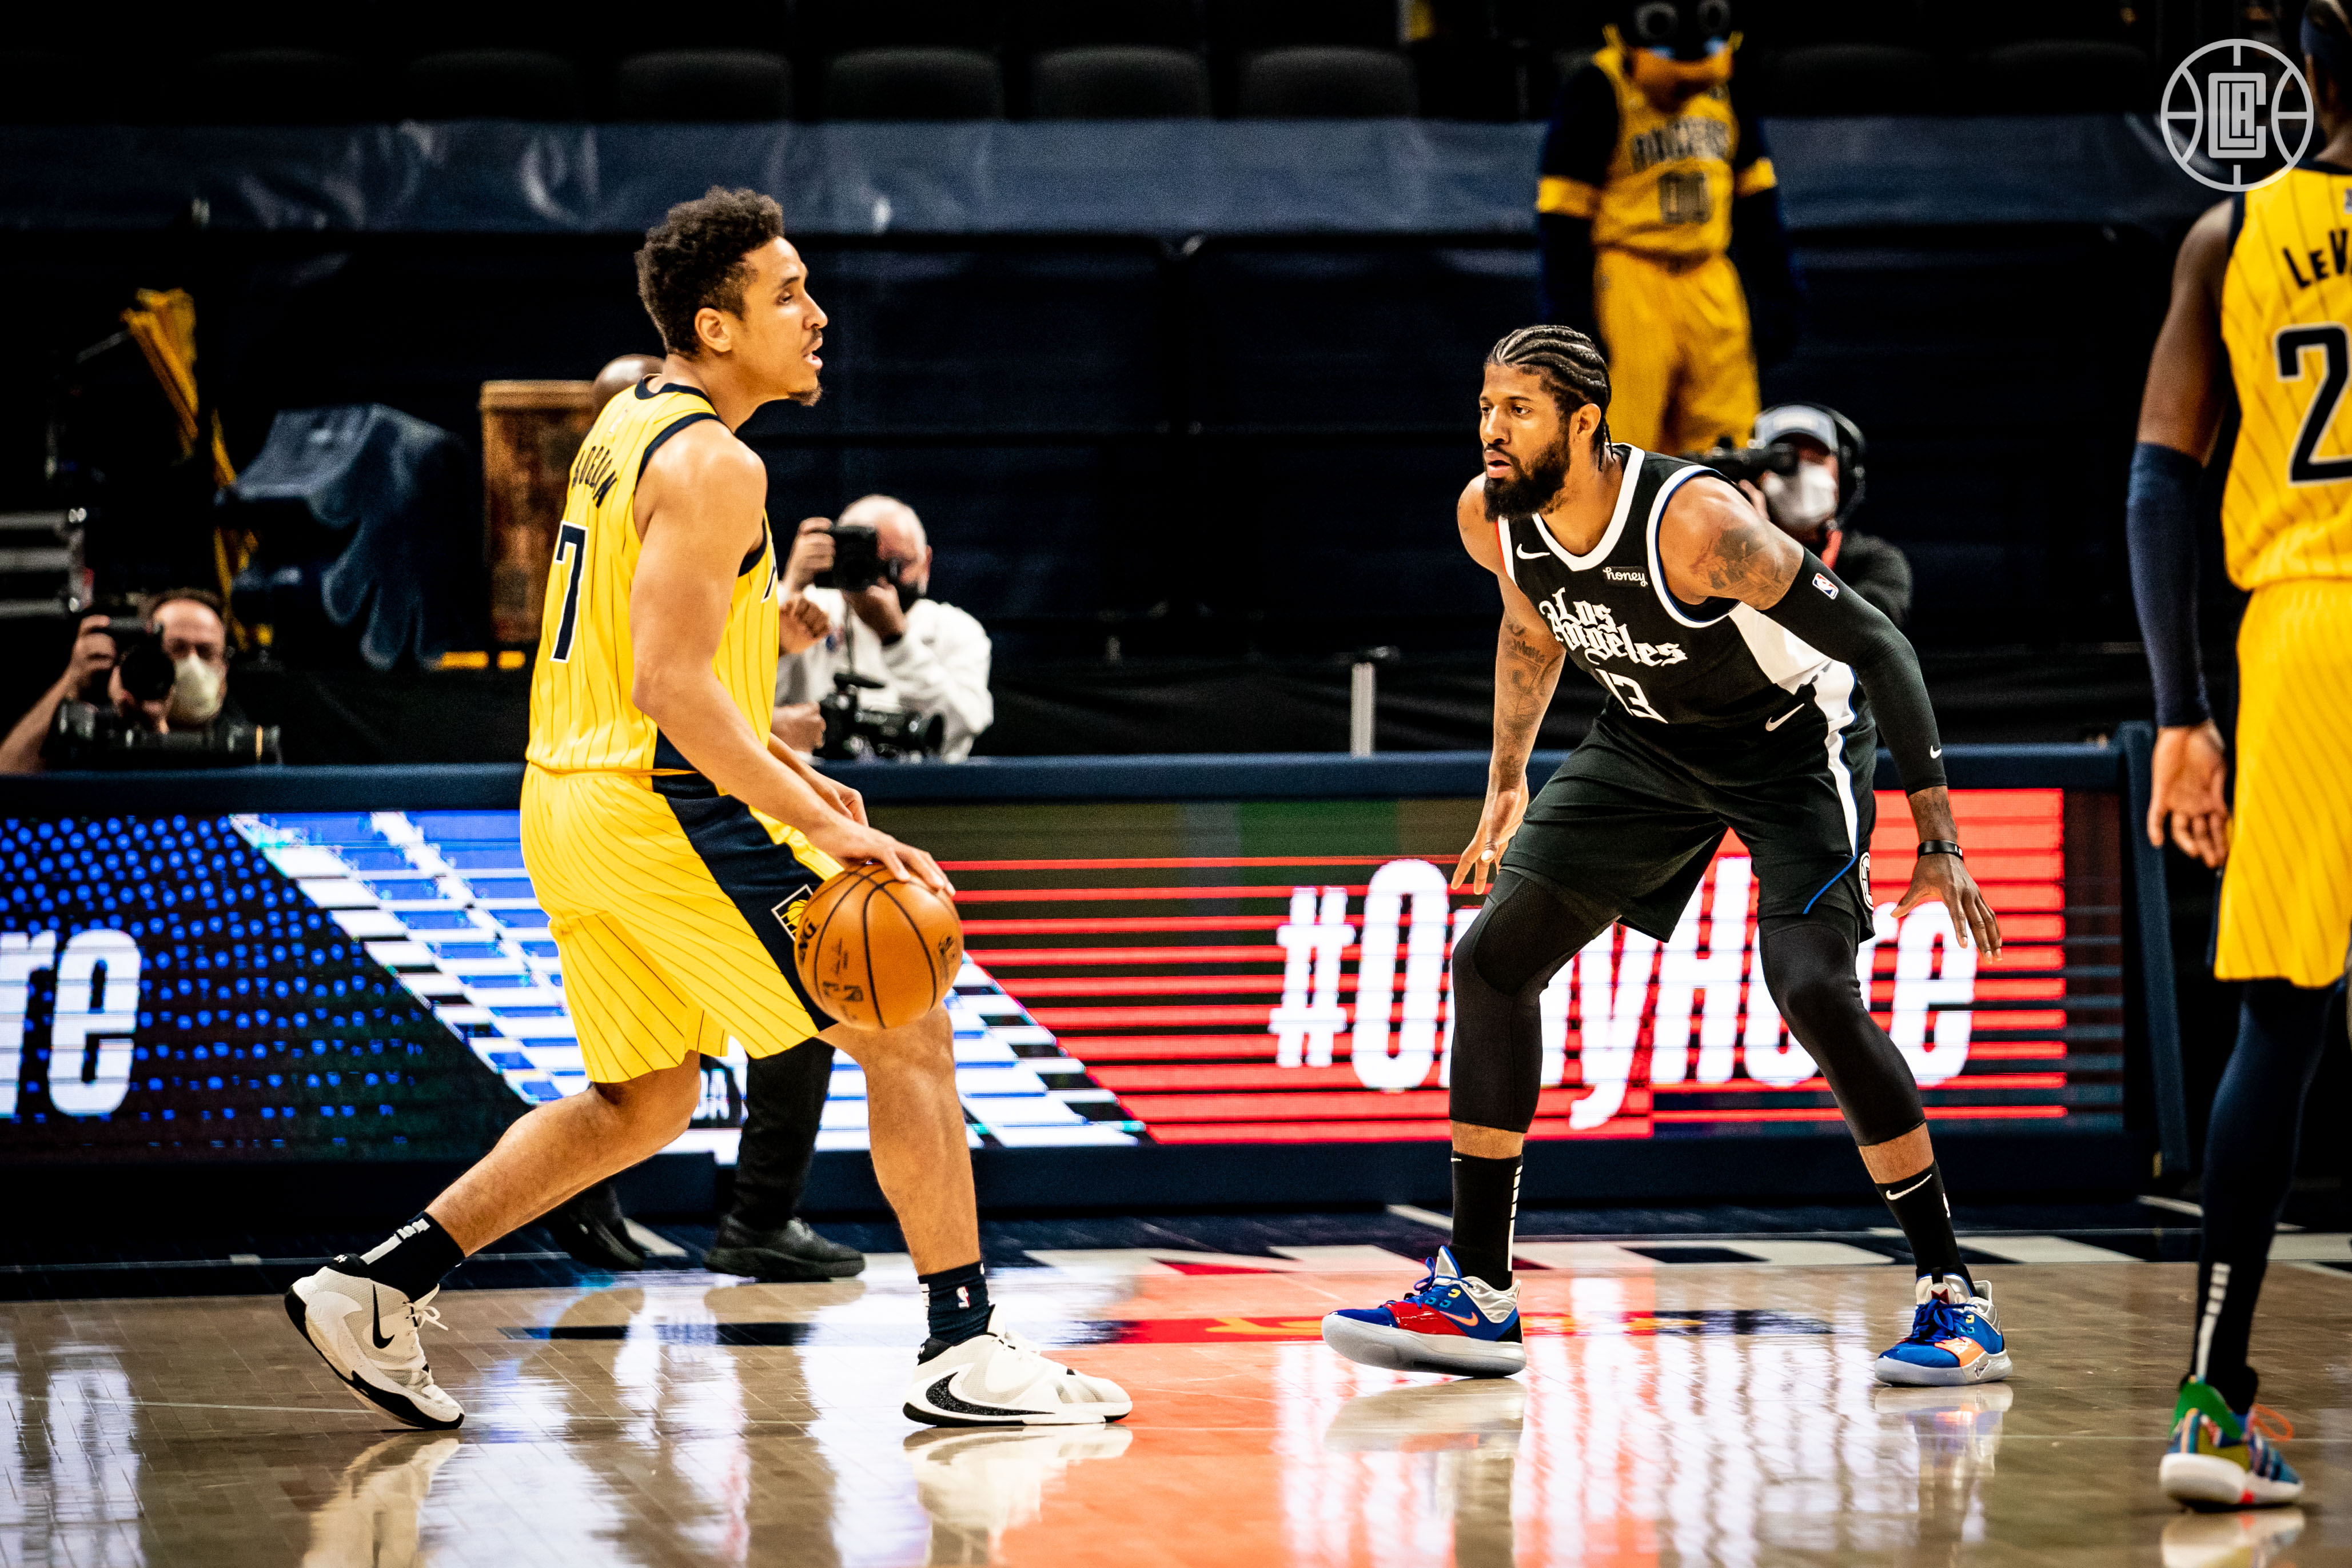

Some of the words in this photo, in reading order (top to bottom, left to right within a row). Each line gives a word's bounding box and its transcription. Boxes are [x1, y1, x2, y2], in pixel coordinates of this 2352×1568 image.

[549, 520, 588, 664] 7
[1602, 566, 1648, 587] honey
[1539, 600, 1688, 667] Angeles
[1552, 586, 1618, 633] Los
[1594, 668, 1669, 724] 13
[1267, 856, 1977, 1130] #OyHe
